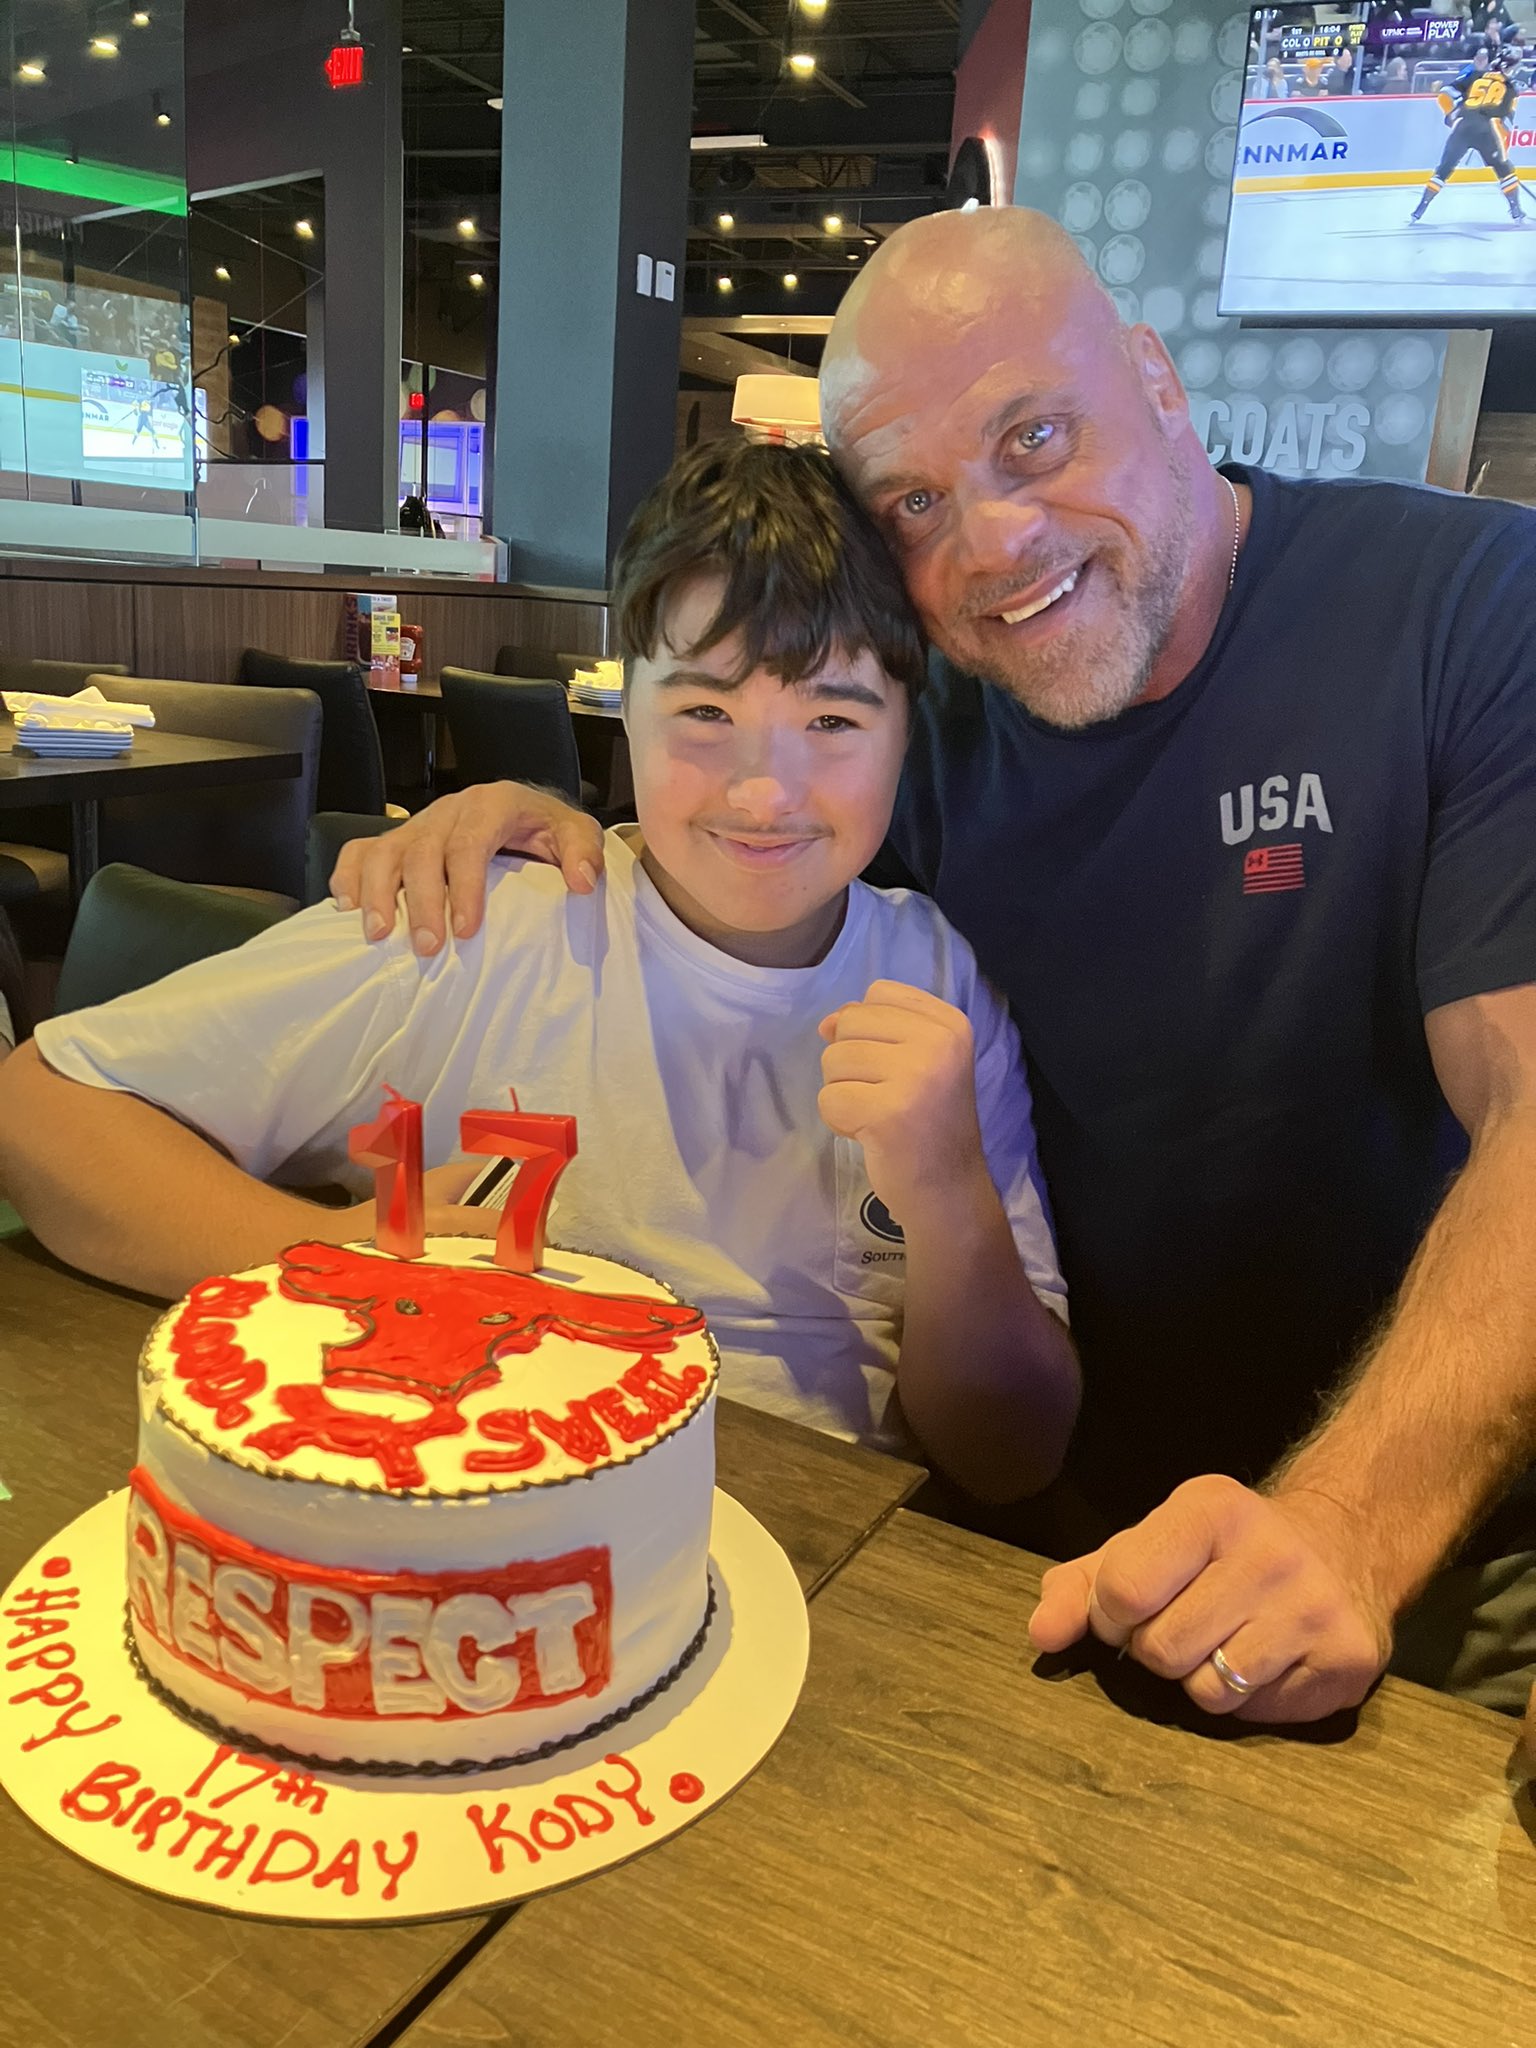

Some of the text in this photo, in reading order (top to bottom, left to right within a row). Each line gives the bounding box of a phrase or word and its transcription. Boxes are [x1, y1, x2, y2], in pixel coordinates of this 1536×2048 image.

[1282, 38, 1301, 48] COL
[1313, 36, 1331, 47] PIT
[1382, 28, 1405, 36] UPMC
[1427, 28, 1459, 40] PLAY
[1429, 20, 1460, 29] POWER
[1237, 141, 1349, 165] NNMAR
[1201, 400, 1371, 471] COATS
[1219, 772, 1334, 846] USA
[126, 1489, 597, 1715] RESPECT
[3, 1586, 122, 1753] HAPPY
[60, 1761, 418, 1901] BIRTHDAY
[466, 1753, 655, 1874] KODY
